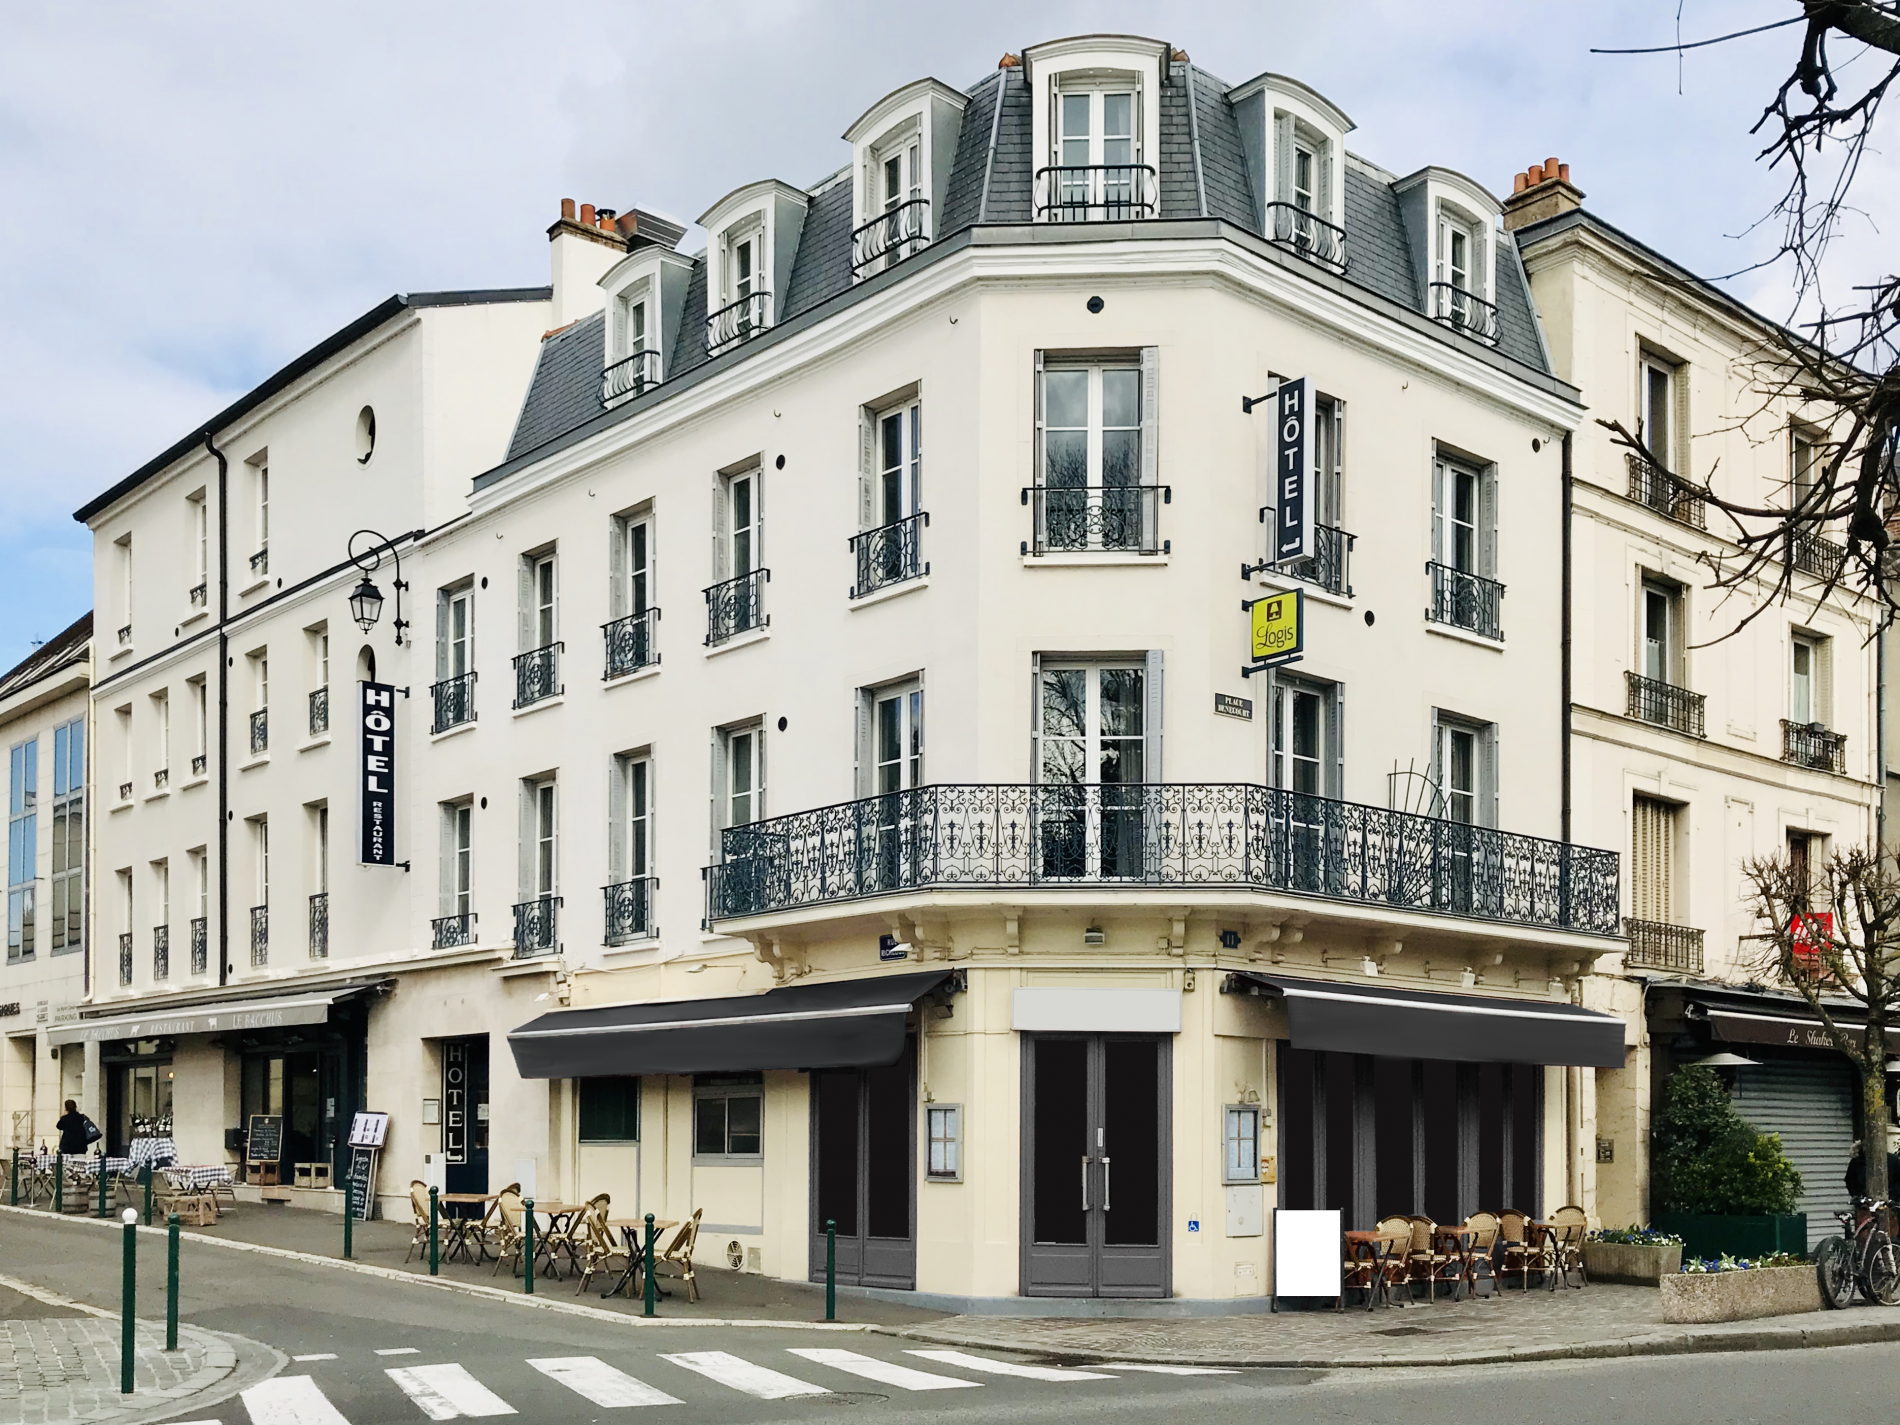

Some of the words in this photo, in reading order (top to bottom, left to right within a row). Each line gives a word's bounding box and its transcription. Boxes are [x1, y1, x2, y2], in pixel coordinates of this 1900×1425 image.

[1283, 389, 1300, 528] HÔTEL
[1255, 622, 1294, 650] Logis
[1224, 696, 1244, 707] PLACE
[365, 688, 391, 794] HÔTEL
[372, 801, 384, 861] RESTAURANT
[54, 1013, 78, 1023] PARKING
[149, 1020, 195, 1034] RESTAURANT
[232, 1015, 243, 1029] LE
[244, 1011, 283, 1028] BACCHUS
[1786, 1028, 1800, 1044] Le
[447, 1045, 463, 1149] HOTEL
